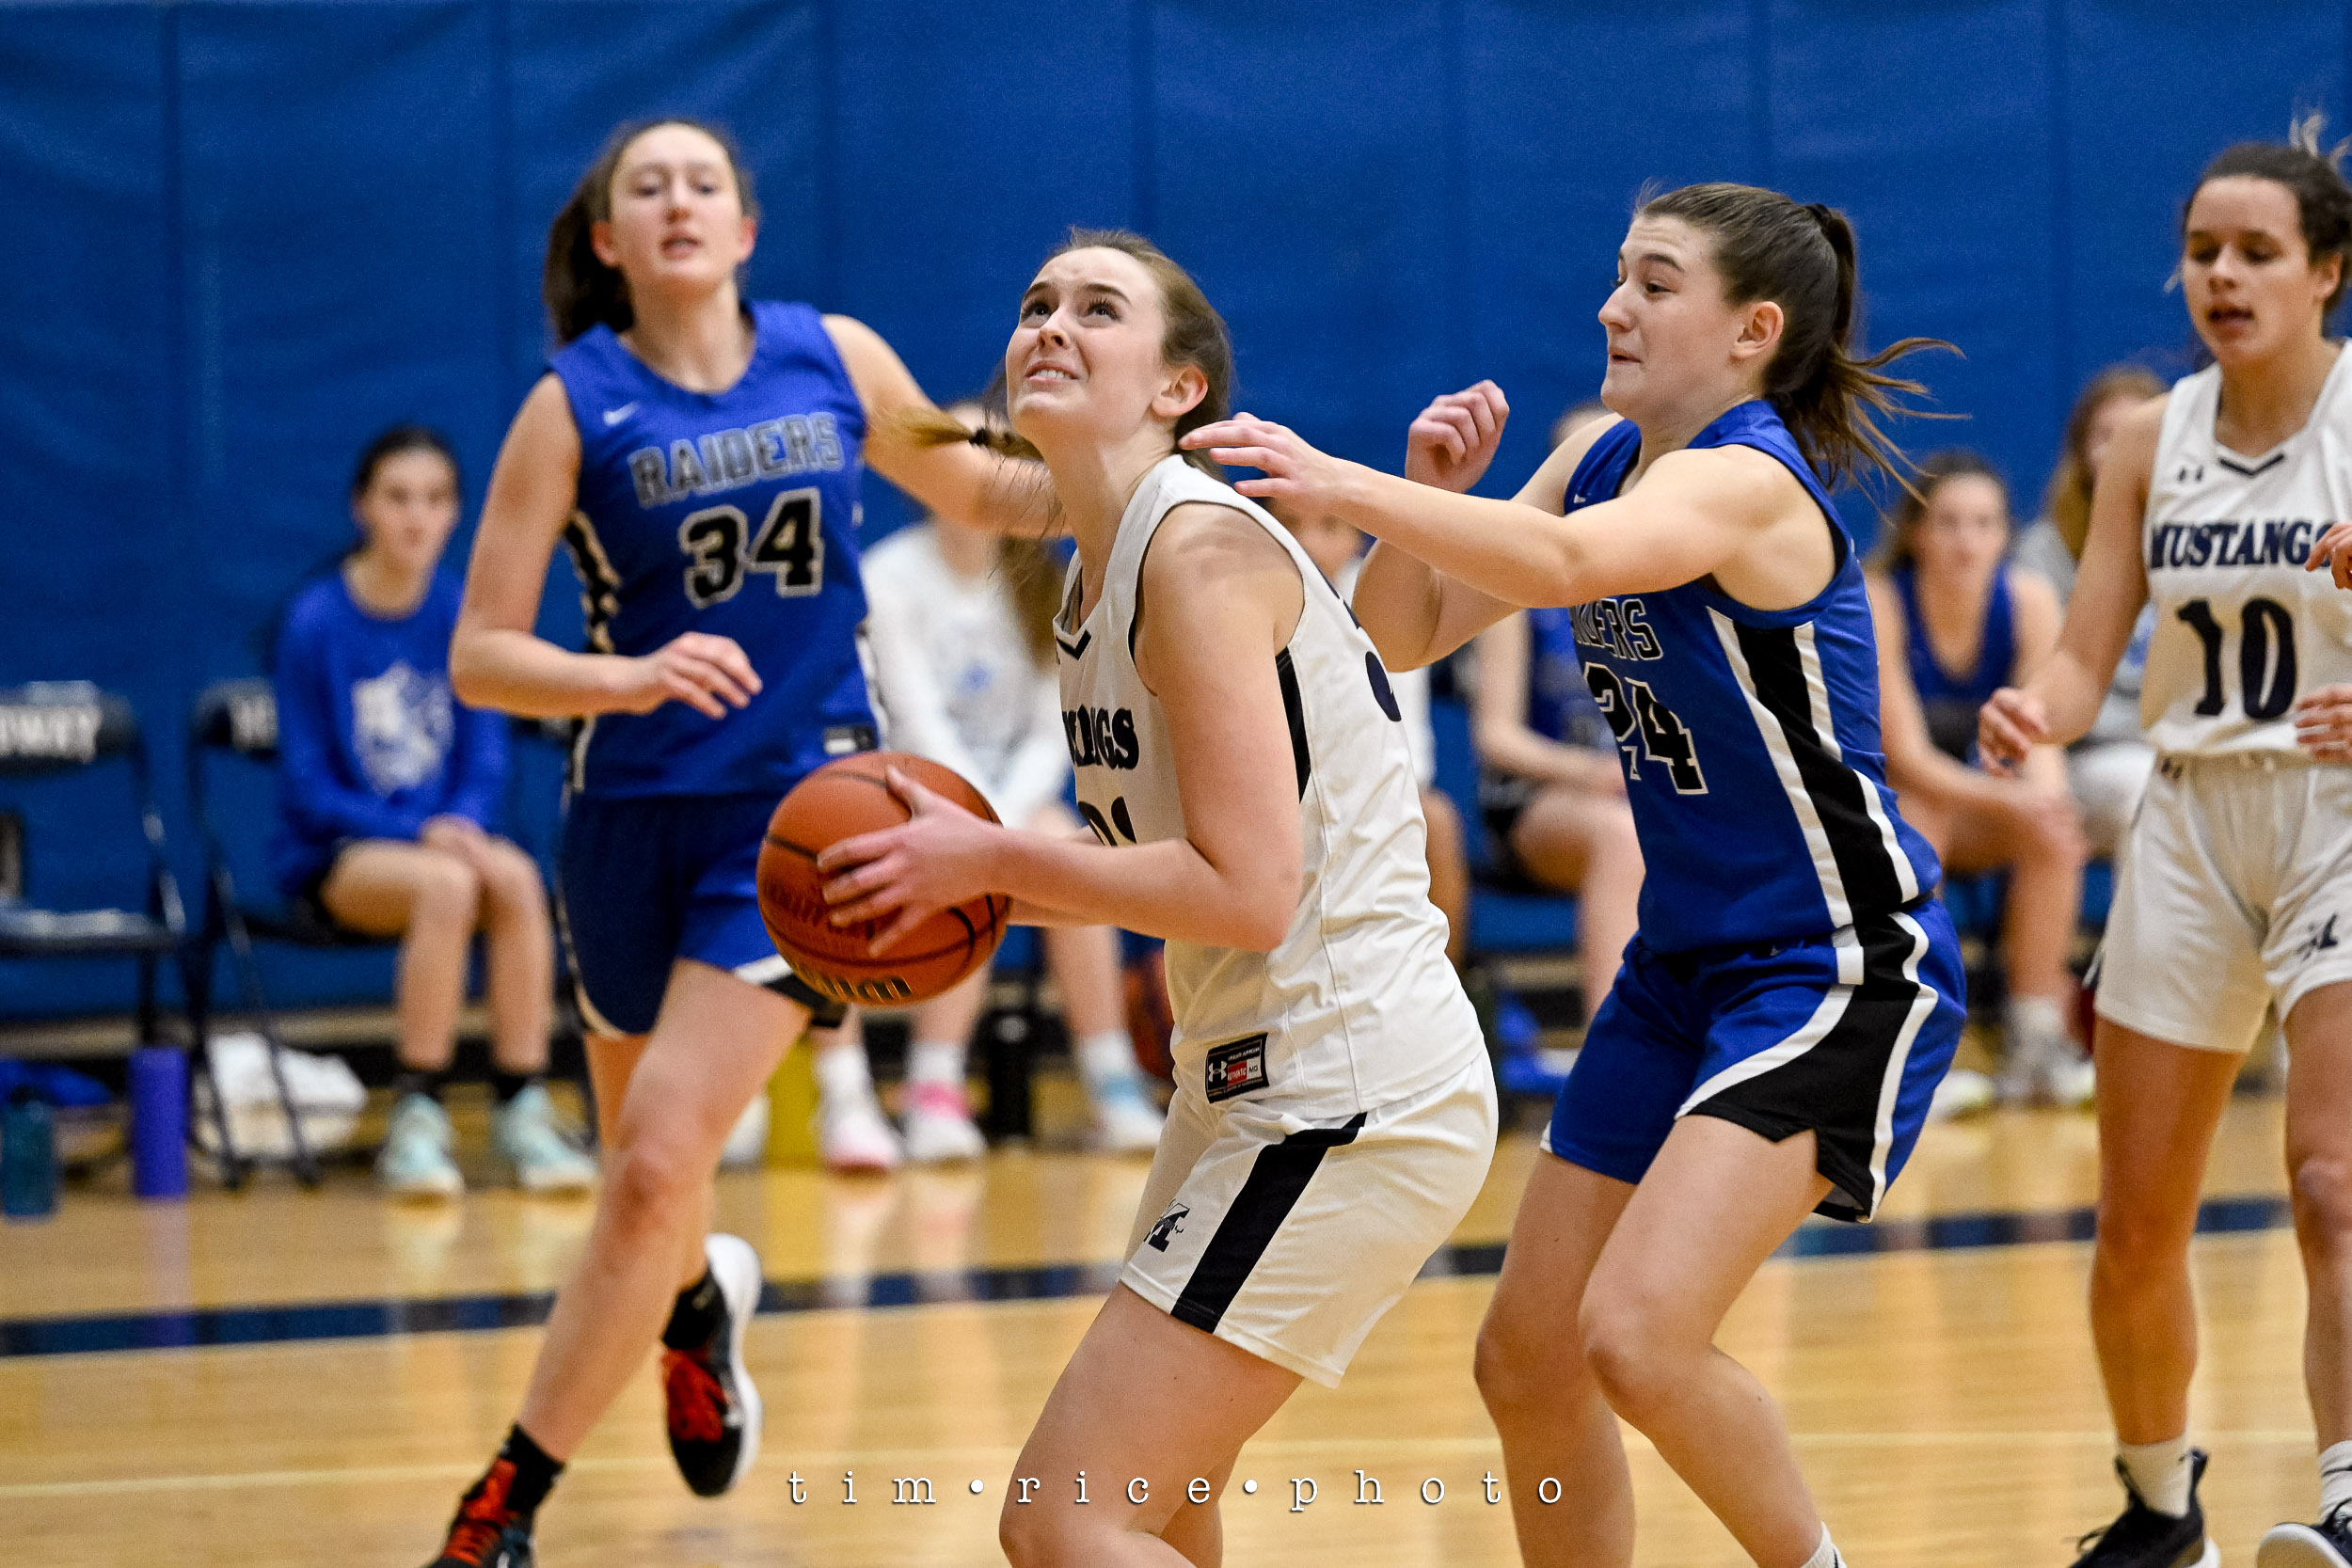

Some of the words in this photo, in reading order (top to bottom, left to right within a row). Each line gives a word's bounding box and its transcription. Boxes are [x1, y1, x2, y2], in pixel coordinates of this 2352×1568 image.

[628, 411, 845, 509] RAIDERS
[677, 486, 824, 610] 34
[2175, 596, 2296, 721] 10
[1582, 661, 1709, 795] 24
